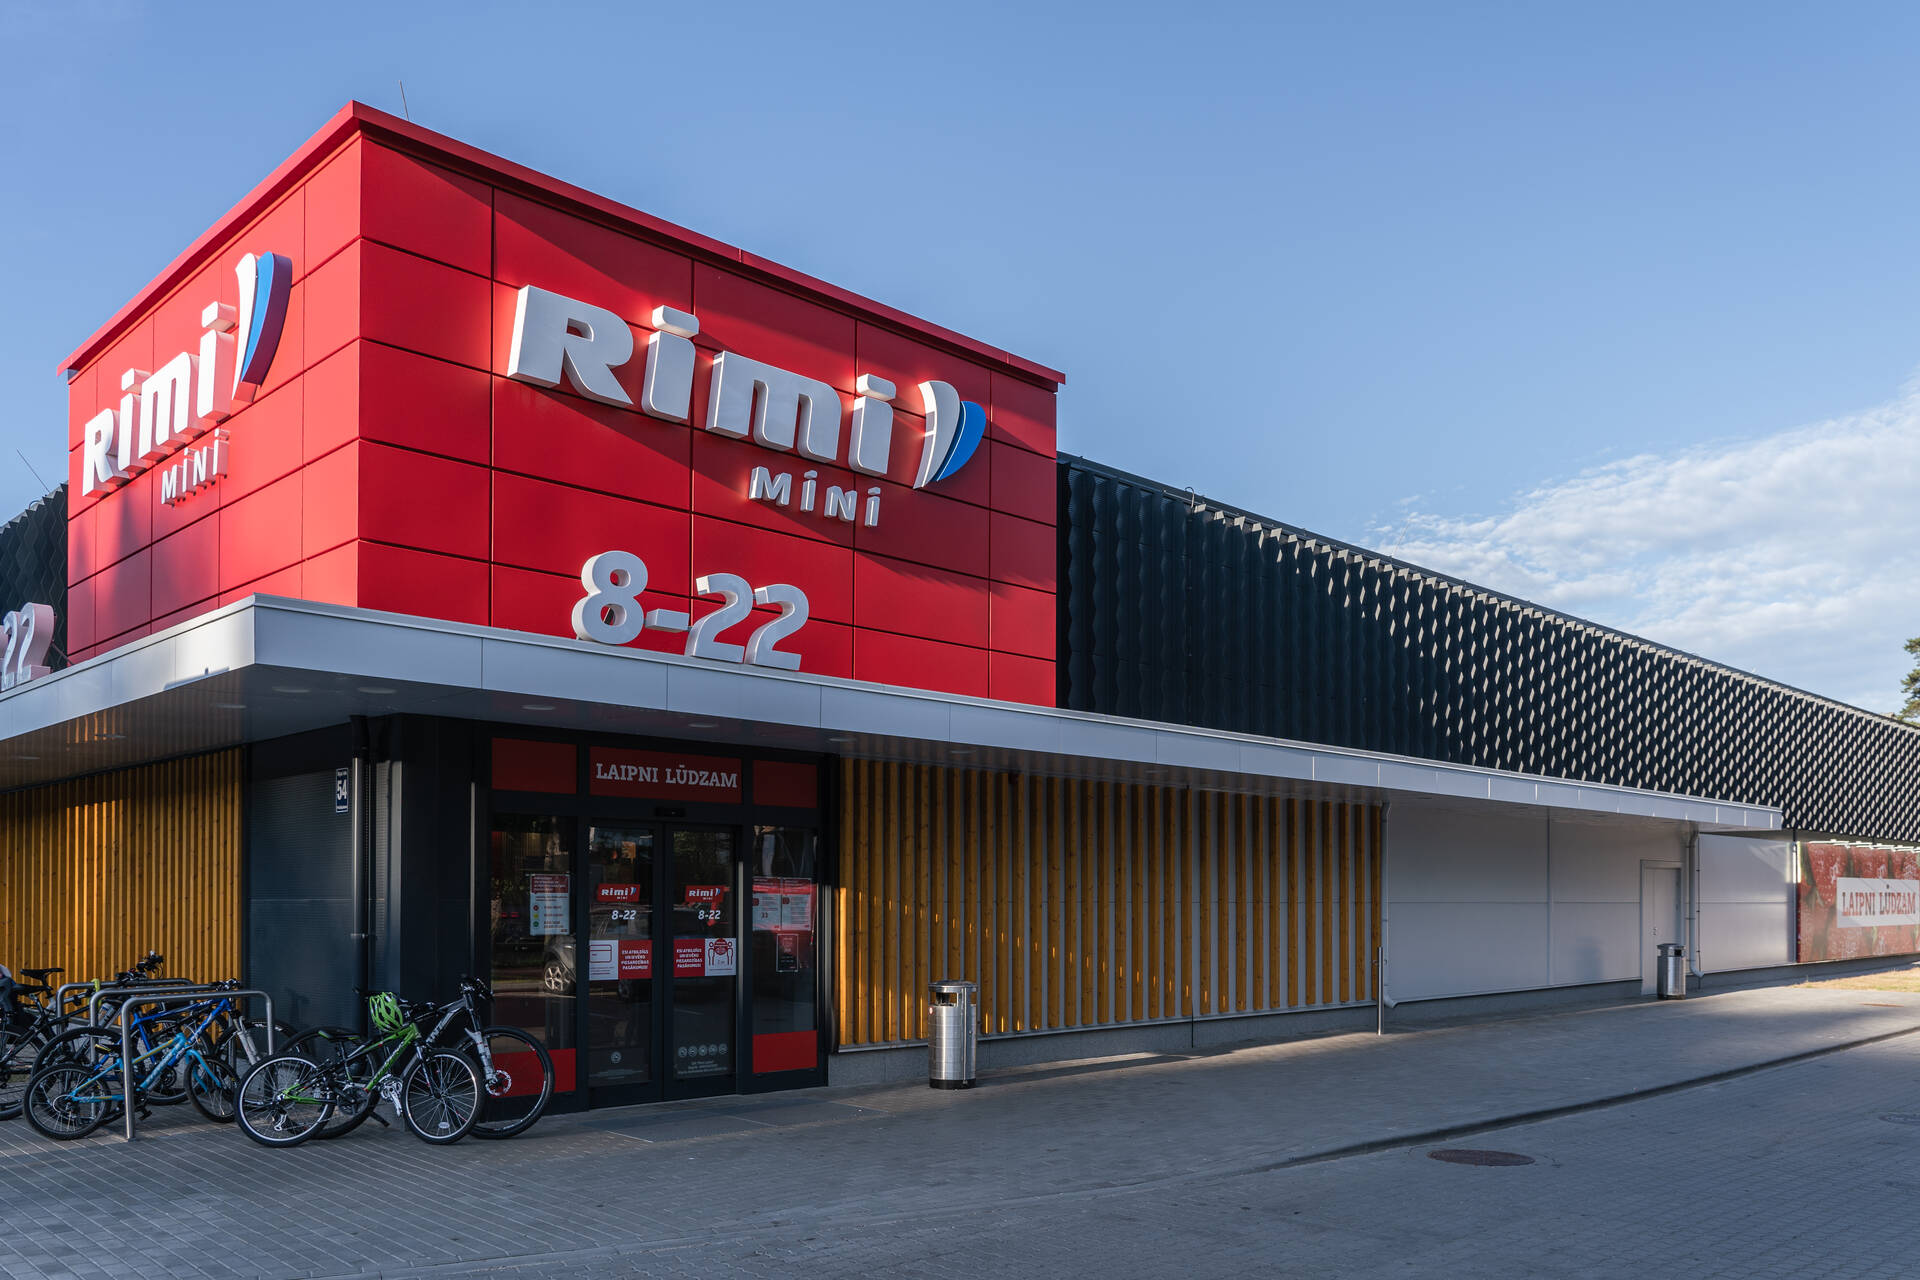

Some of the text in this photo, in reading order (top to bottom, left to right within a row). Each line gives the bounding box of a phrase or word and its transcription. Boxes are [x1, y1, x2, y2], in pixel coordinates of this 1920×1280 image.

[508, 284, 896, 476] Rimi
[82, 301, 236, 498] Rimi
[572, 550, 809, 671] 8-22
[596, 762, 738, 788] LAIPNI LŪDZAM
[601, 887, 629, 896] Rimi
[688, 888, 714, 897] Rimi
[1842, 891, 1876, 916] LAIPNI
[611, 909, 637, 920] 8-22
[697, 909, 721, 920] 8-22
